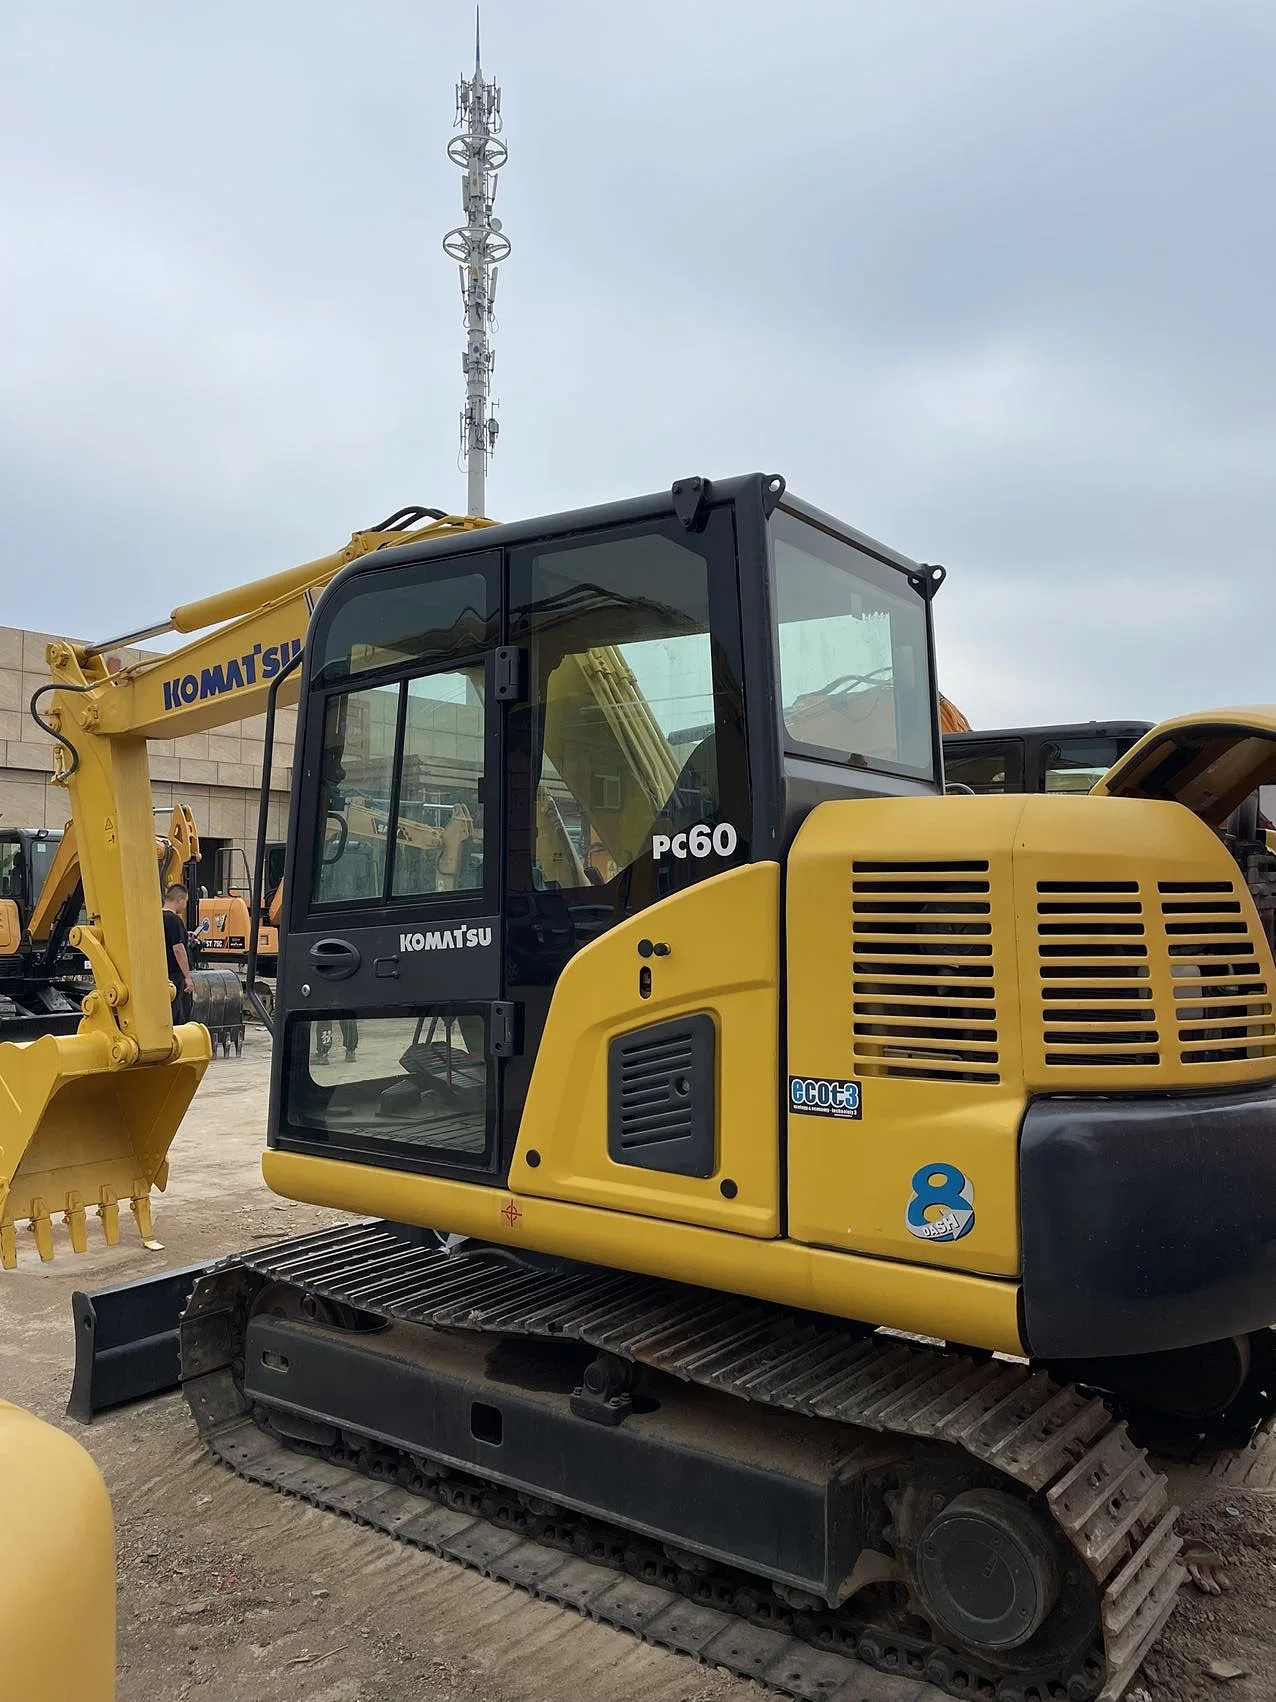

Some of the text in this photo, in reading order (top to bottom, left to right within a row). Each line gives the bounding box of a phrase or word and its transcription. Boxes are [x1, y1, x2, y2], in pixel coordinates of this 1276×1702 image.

[163, 638, 301, 710] KOMATSU
[652, 822, 738, 860] PC60
[400, 924, 492, 952] KOMATSU
[791, 1079, 859, 1109] ecot3
[907, 1162, 975, 1242] 8
[922, 1213, 960, 1237] DASH
